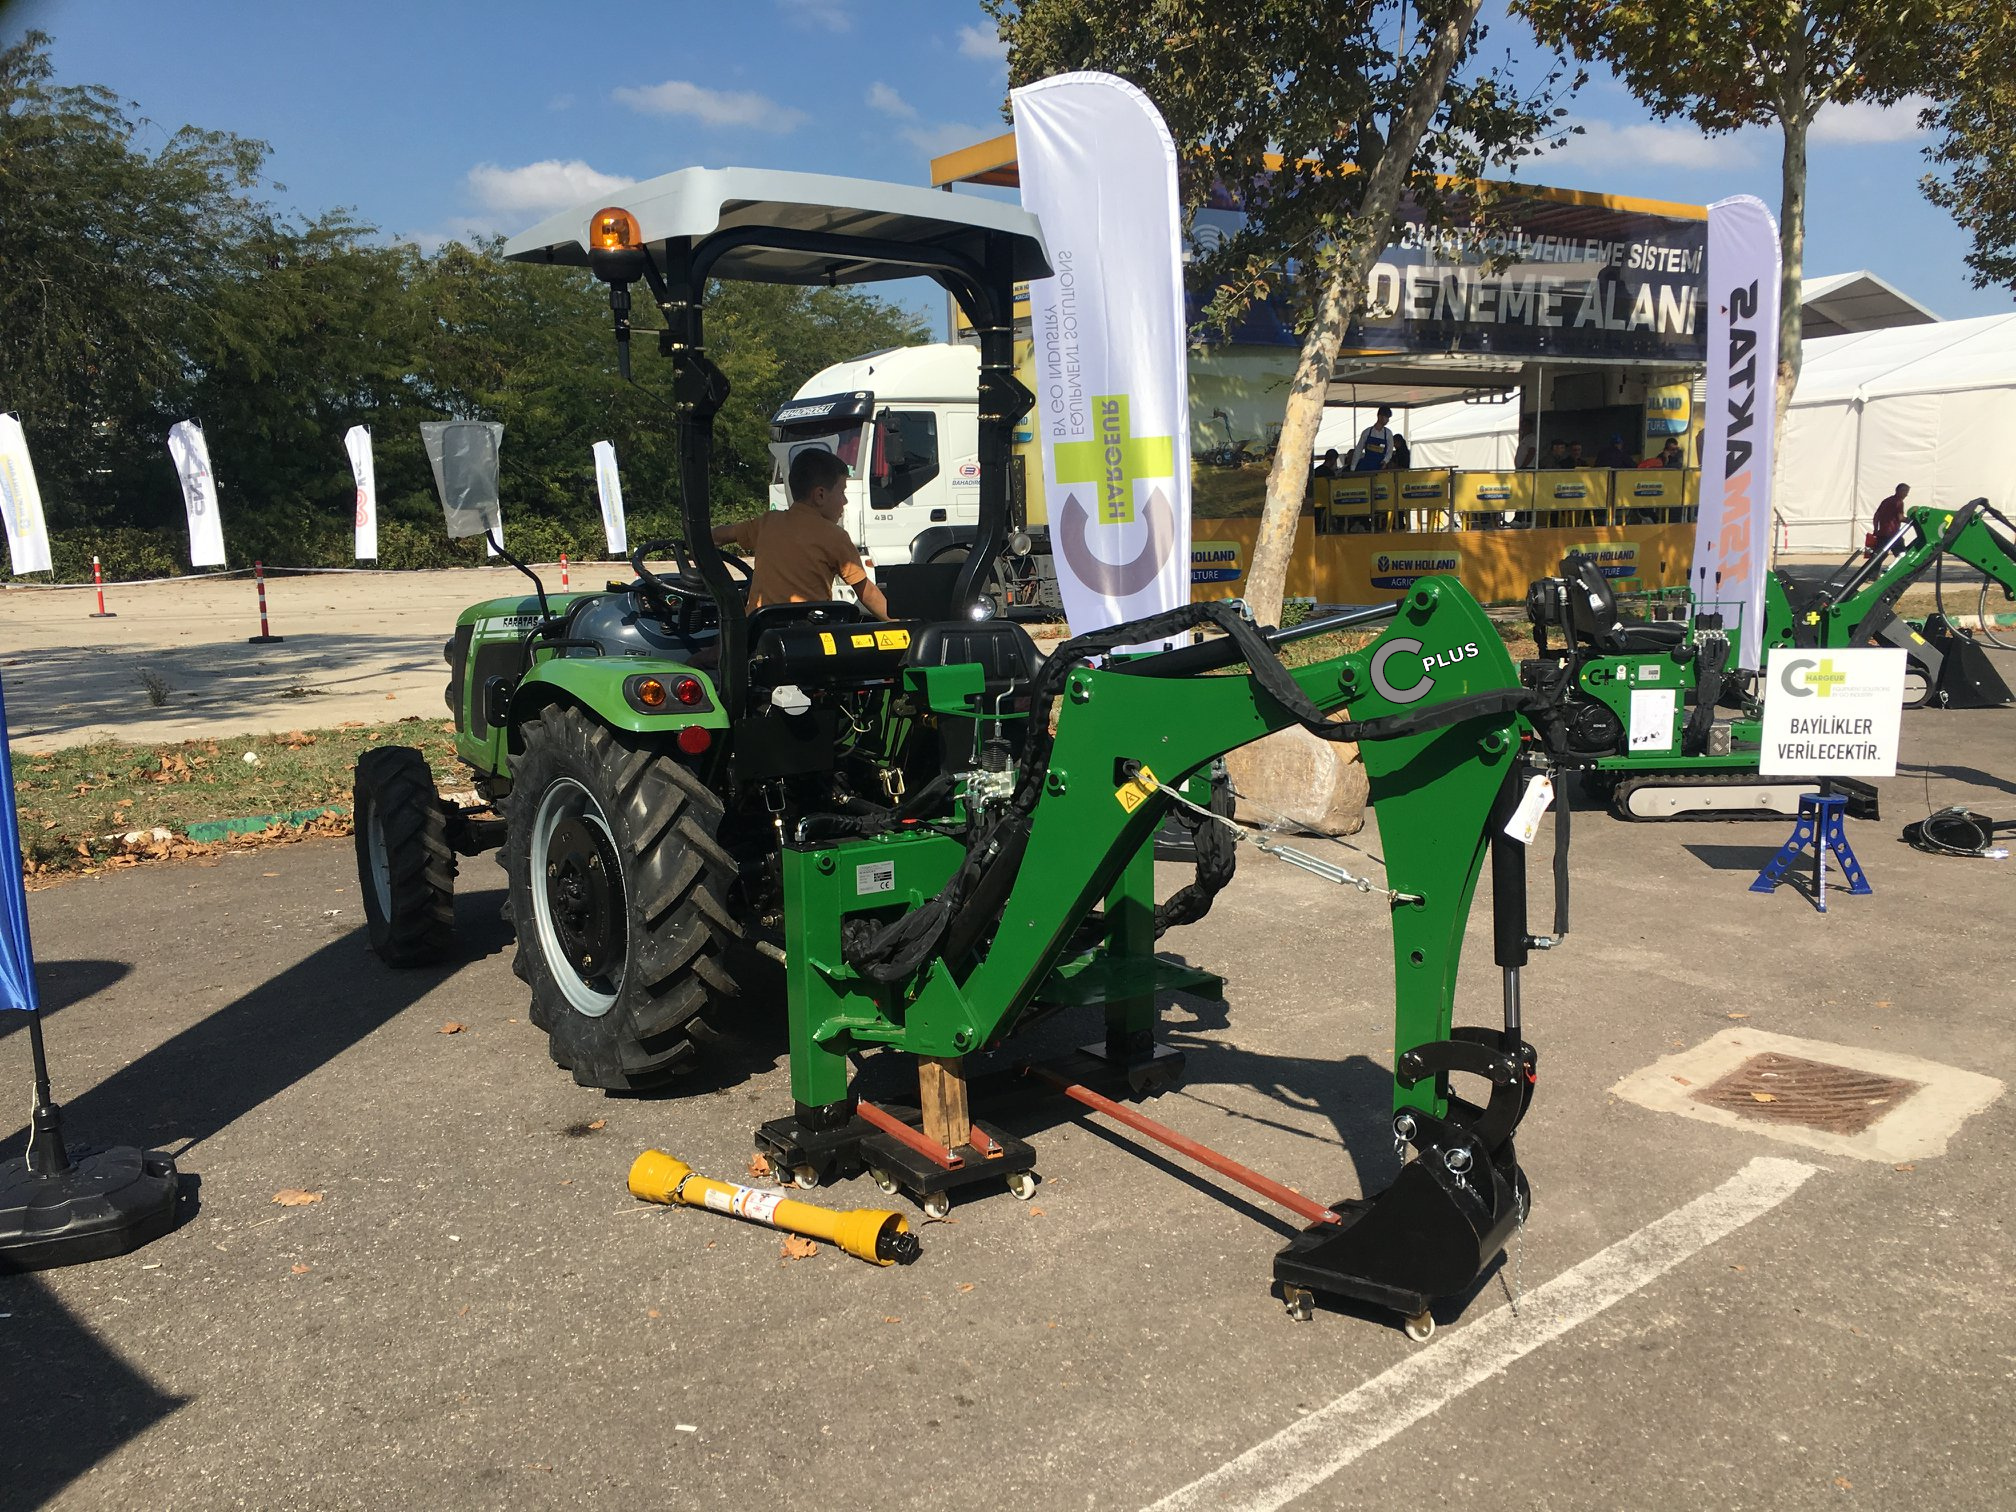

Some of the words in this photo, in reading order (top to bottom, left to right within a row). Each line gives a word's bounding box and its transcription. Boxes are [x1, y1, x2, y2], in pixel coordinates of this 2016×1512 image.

[1627, 239, 1703, 274] SİSTEMİ
[1366, 262, 1566, 328] DENEME
[1573, 279, 1699, 336] ALANI
[1600, 550, 1634, 561] HOLLAND
[1391, 559, 1414, 571] NEW
[1415, 558, 1456, 570] HOLLAND
[1191, 570, 1219, 580] LTURE
[1391, 577, 1416, 586] AGRIC
[1422, 642, 1480, 673] PLUS
[1805, 674, 1846, 683] HARGEUR
[1790, 715, 1873, 735] BAYİLİKLER
[1778, 740, 1881, 761] VERİLECEKTİR.
